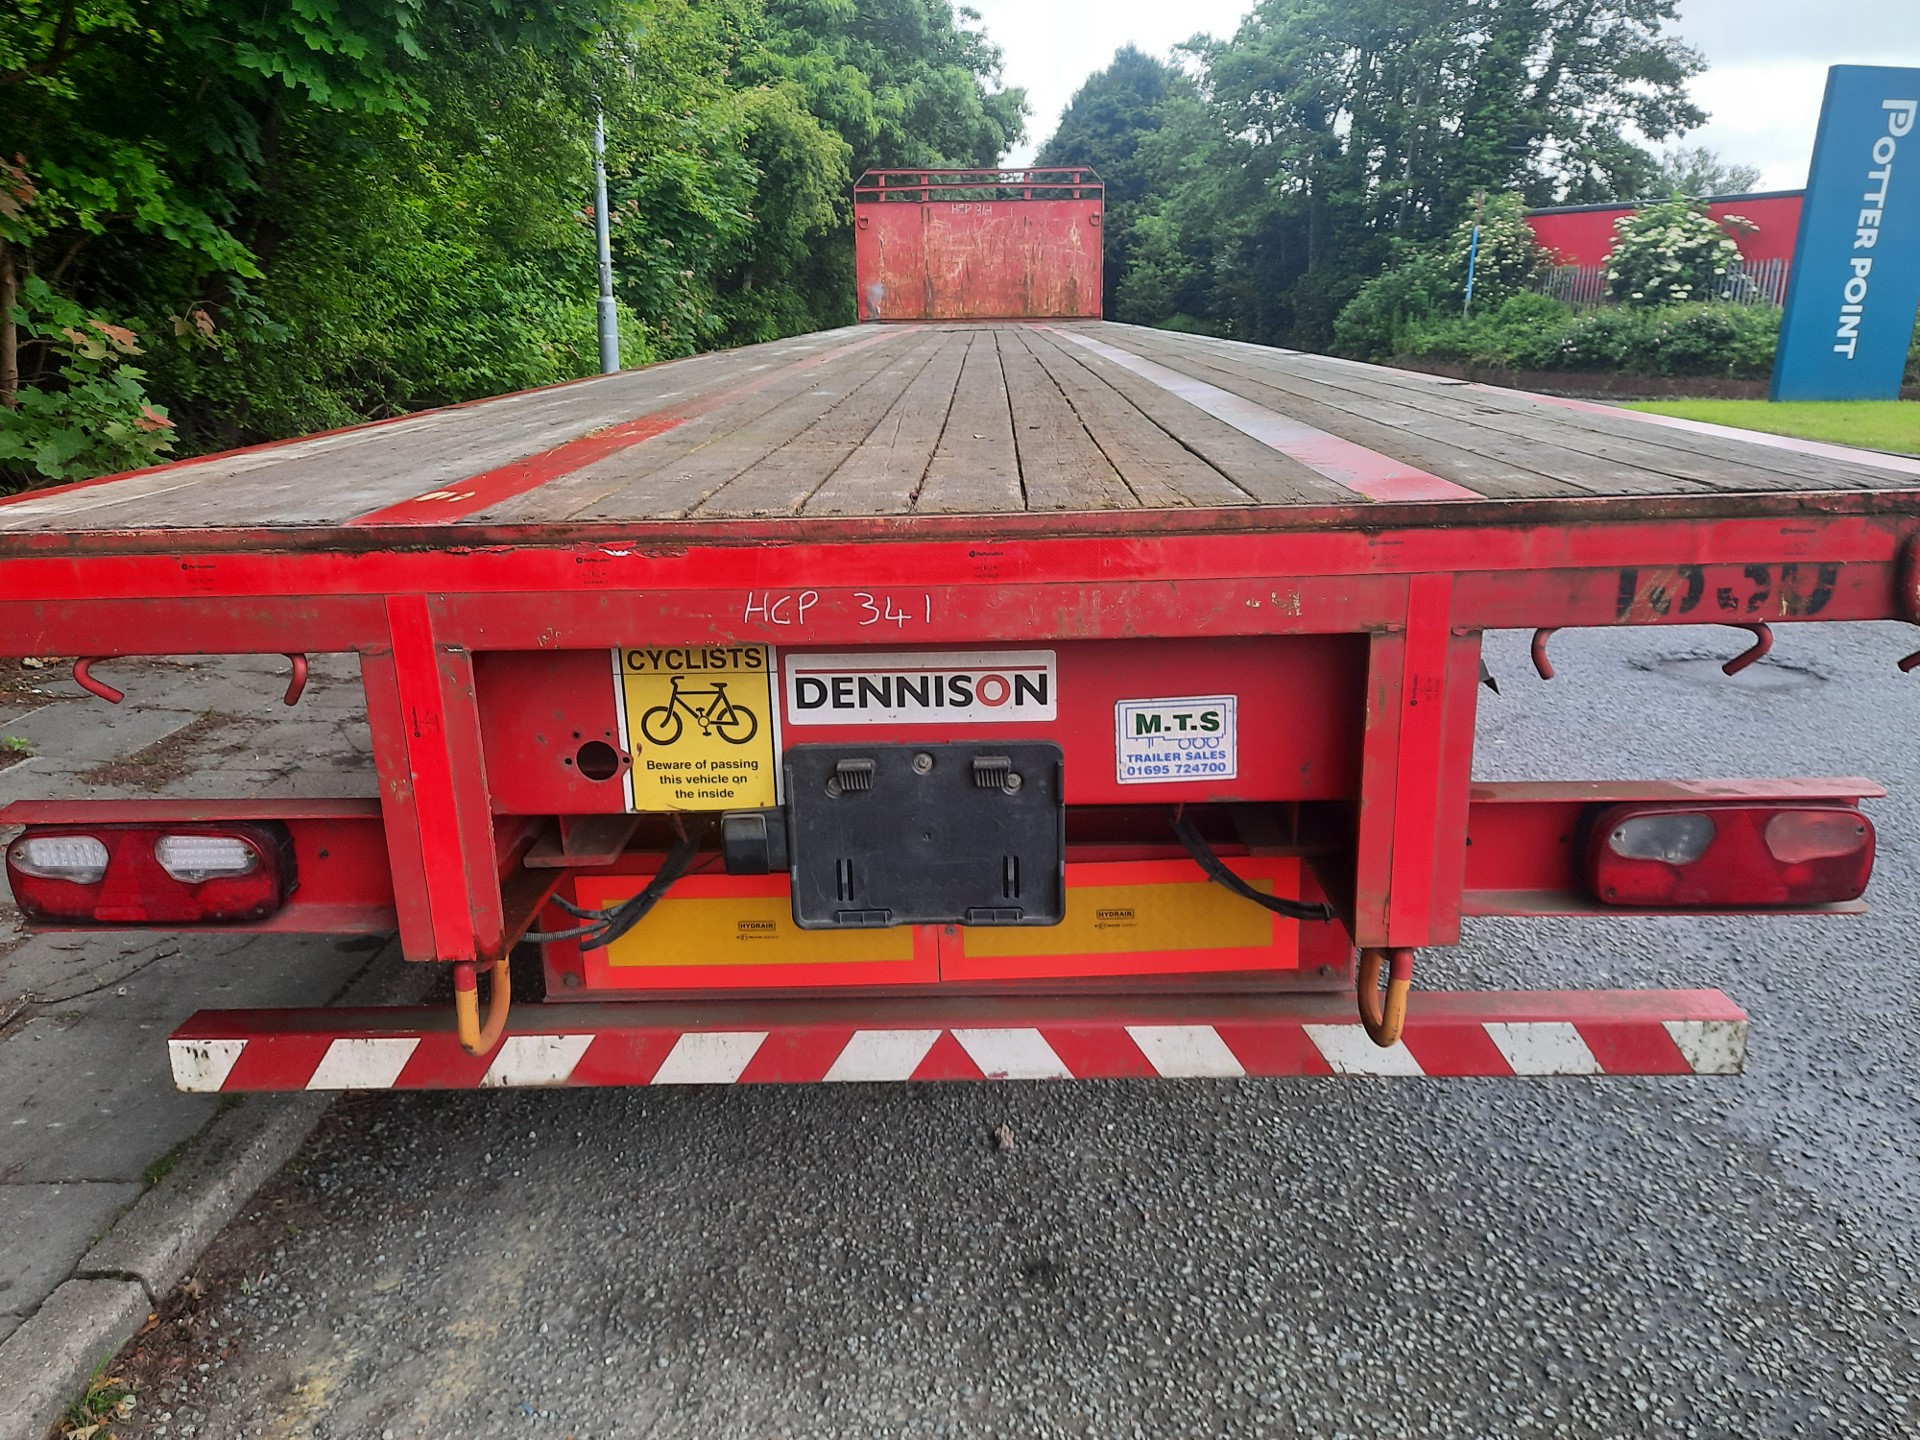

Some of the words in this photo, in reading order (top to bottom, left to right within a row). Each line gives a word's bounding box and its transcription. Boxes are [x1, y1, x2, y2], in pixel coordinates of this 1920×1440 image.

[1853, 99, 1918, 250] POTTER
[1833, 257, 1873, 360] POINT
[744, 590, 819, 625] HCP
[853, 592, 930, 628] 341
[626, 647, 762, 671] CYCLISTS
[795, 674, 1048, 709] DENNISON
[1135, 710, 1220, 735] M.T.S
[646, 760, 692, 770] Beware
[695, 759, 707, 769] of
[710, 758, 759, 772] passing
[1126, 752, 1181, 763] TRAILER
[1185, 750, 1226, 760] SALES
[659, 774, 682, 784] this
[686, 774, 729, 784] vehicle
[732, 775, 748, 784] on
[1126, 764, 1170, 776] 01695
[1174, 762, 1227, 774] 724700
[675, 789, 694, 799] the
[698, 788, 735, 798] inside
